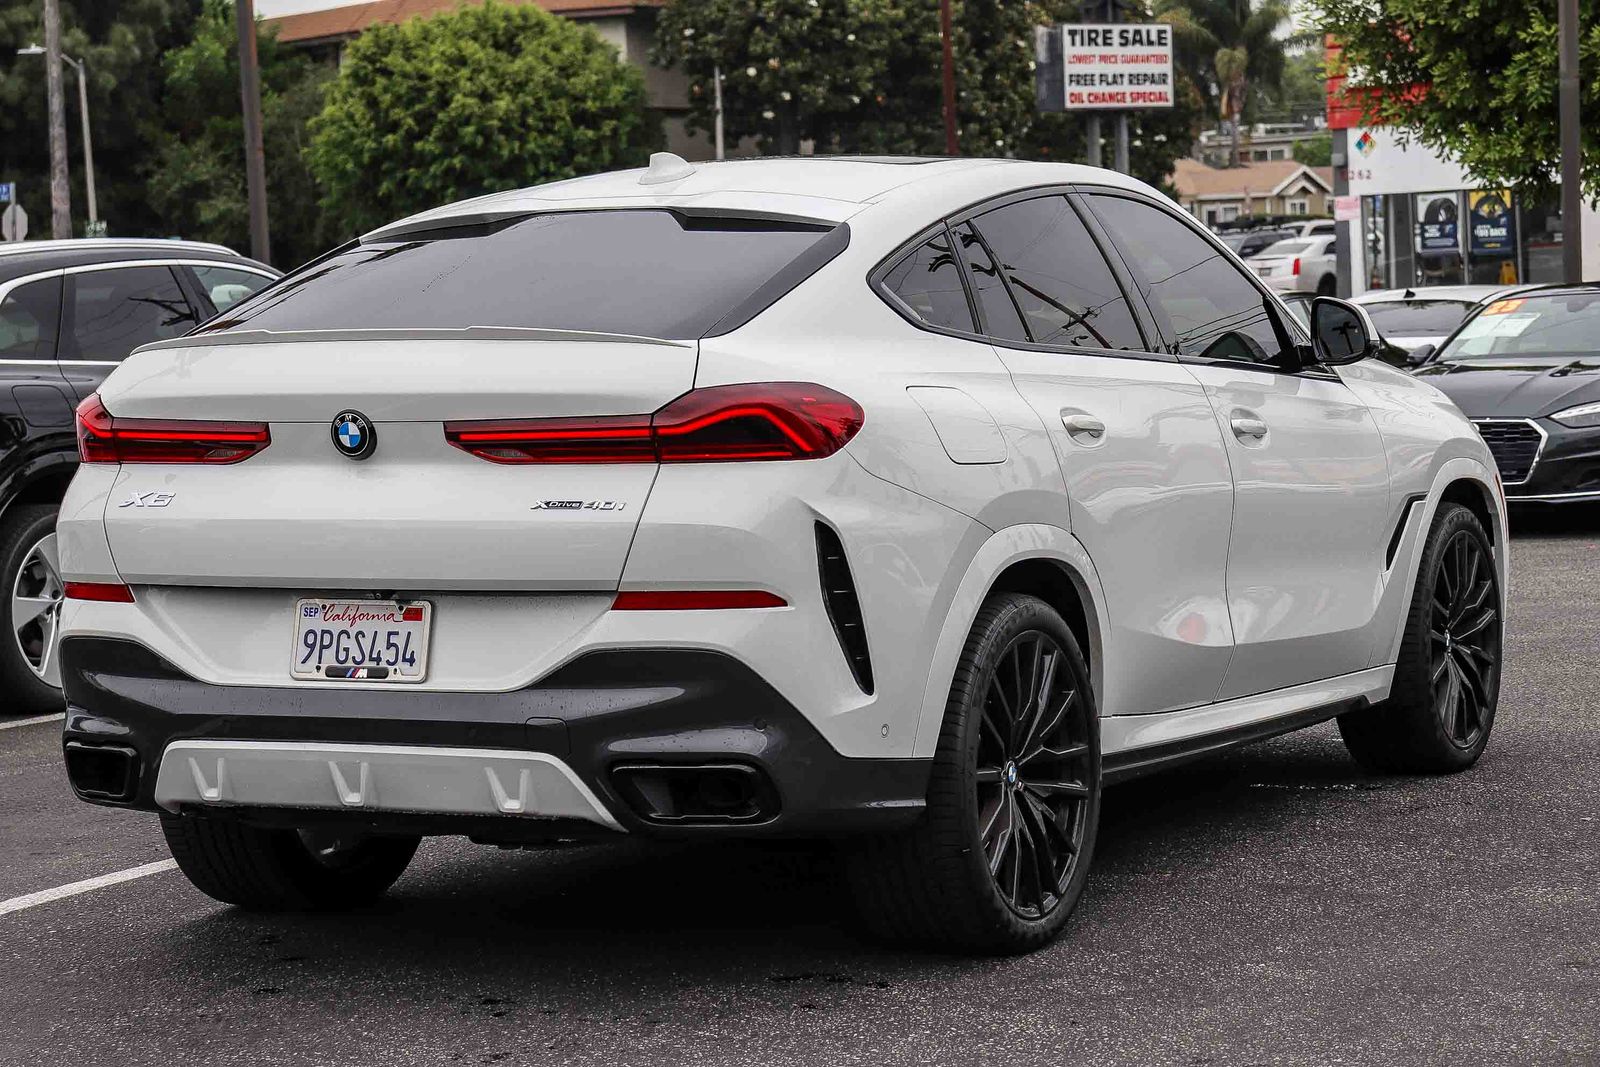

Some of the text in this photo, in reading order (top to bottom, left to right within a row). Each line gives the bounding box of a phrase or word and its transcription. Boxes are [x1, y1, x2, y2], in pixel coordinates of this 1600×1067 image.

[1068, 29, 1168, 47] TIRE SALE
[1068, 54, 1168, 65] LOWEST PRICE GUARANTEED
[1069, 73, 1169, 86] FREE FLAT REPAIR
[1069, 92, 1169, 104] OIL CHANGE SPECIAL
[335, 414, 365, 428] BMW
[119, 490, 176, 508] X6
[303, 607, 319, 618] SEP
[322, 604, 396, 628] California
[300, 628, 416, 667] 9PGS454
